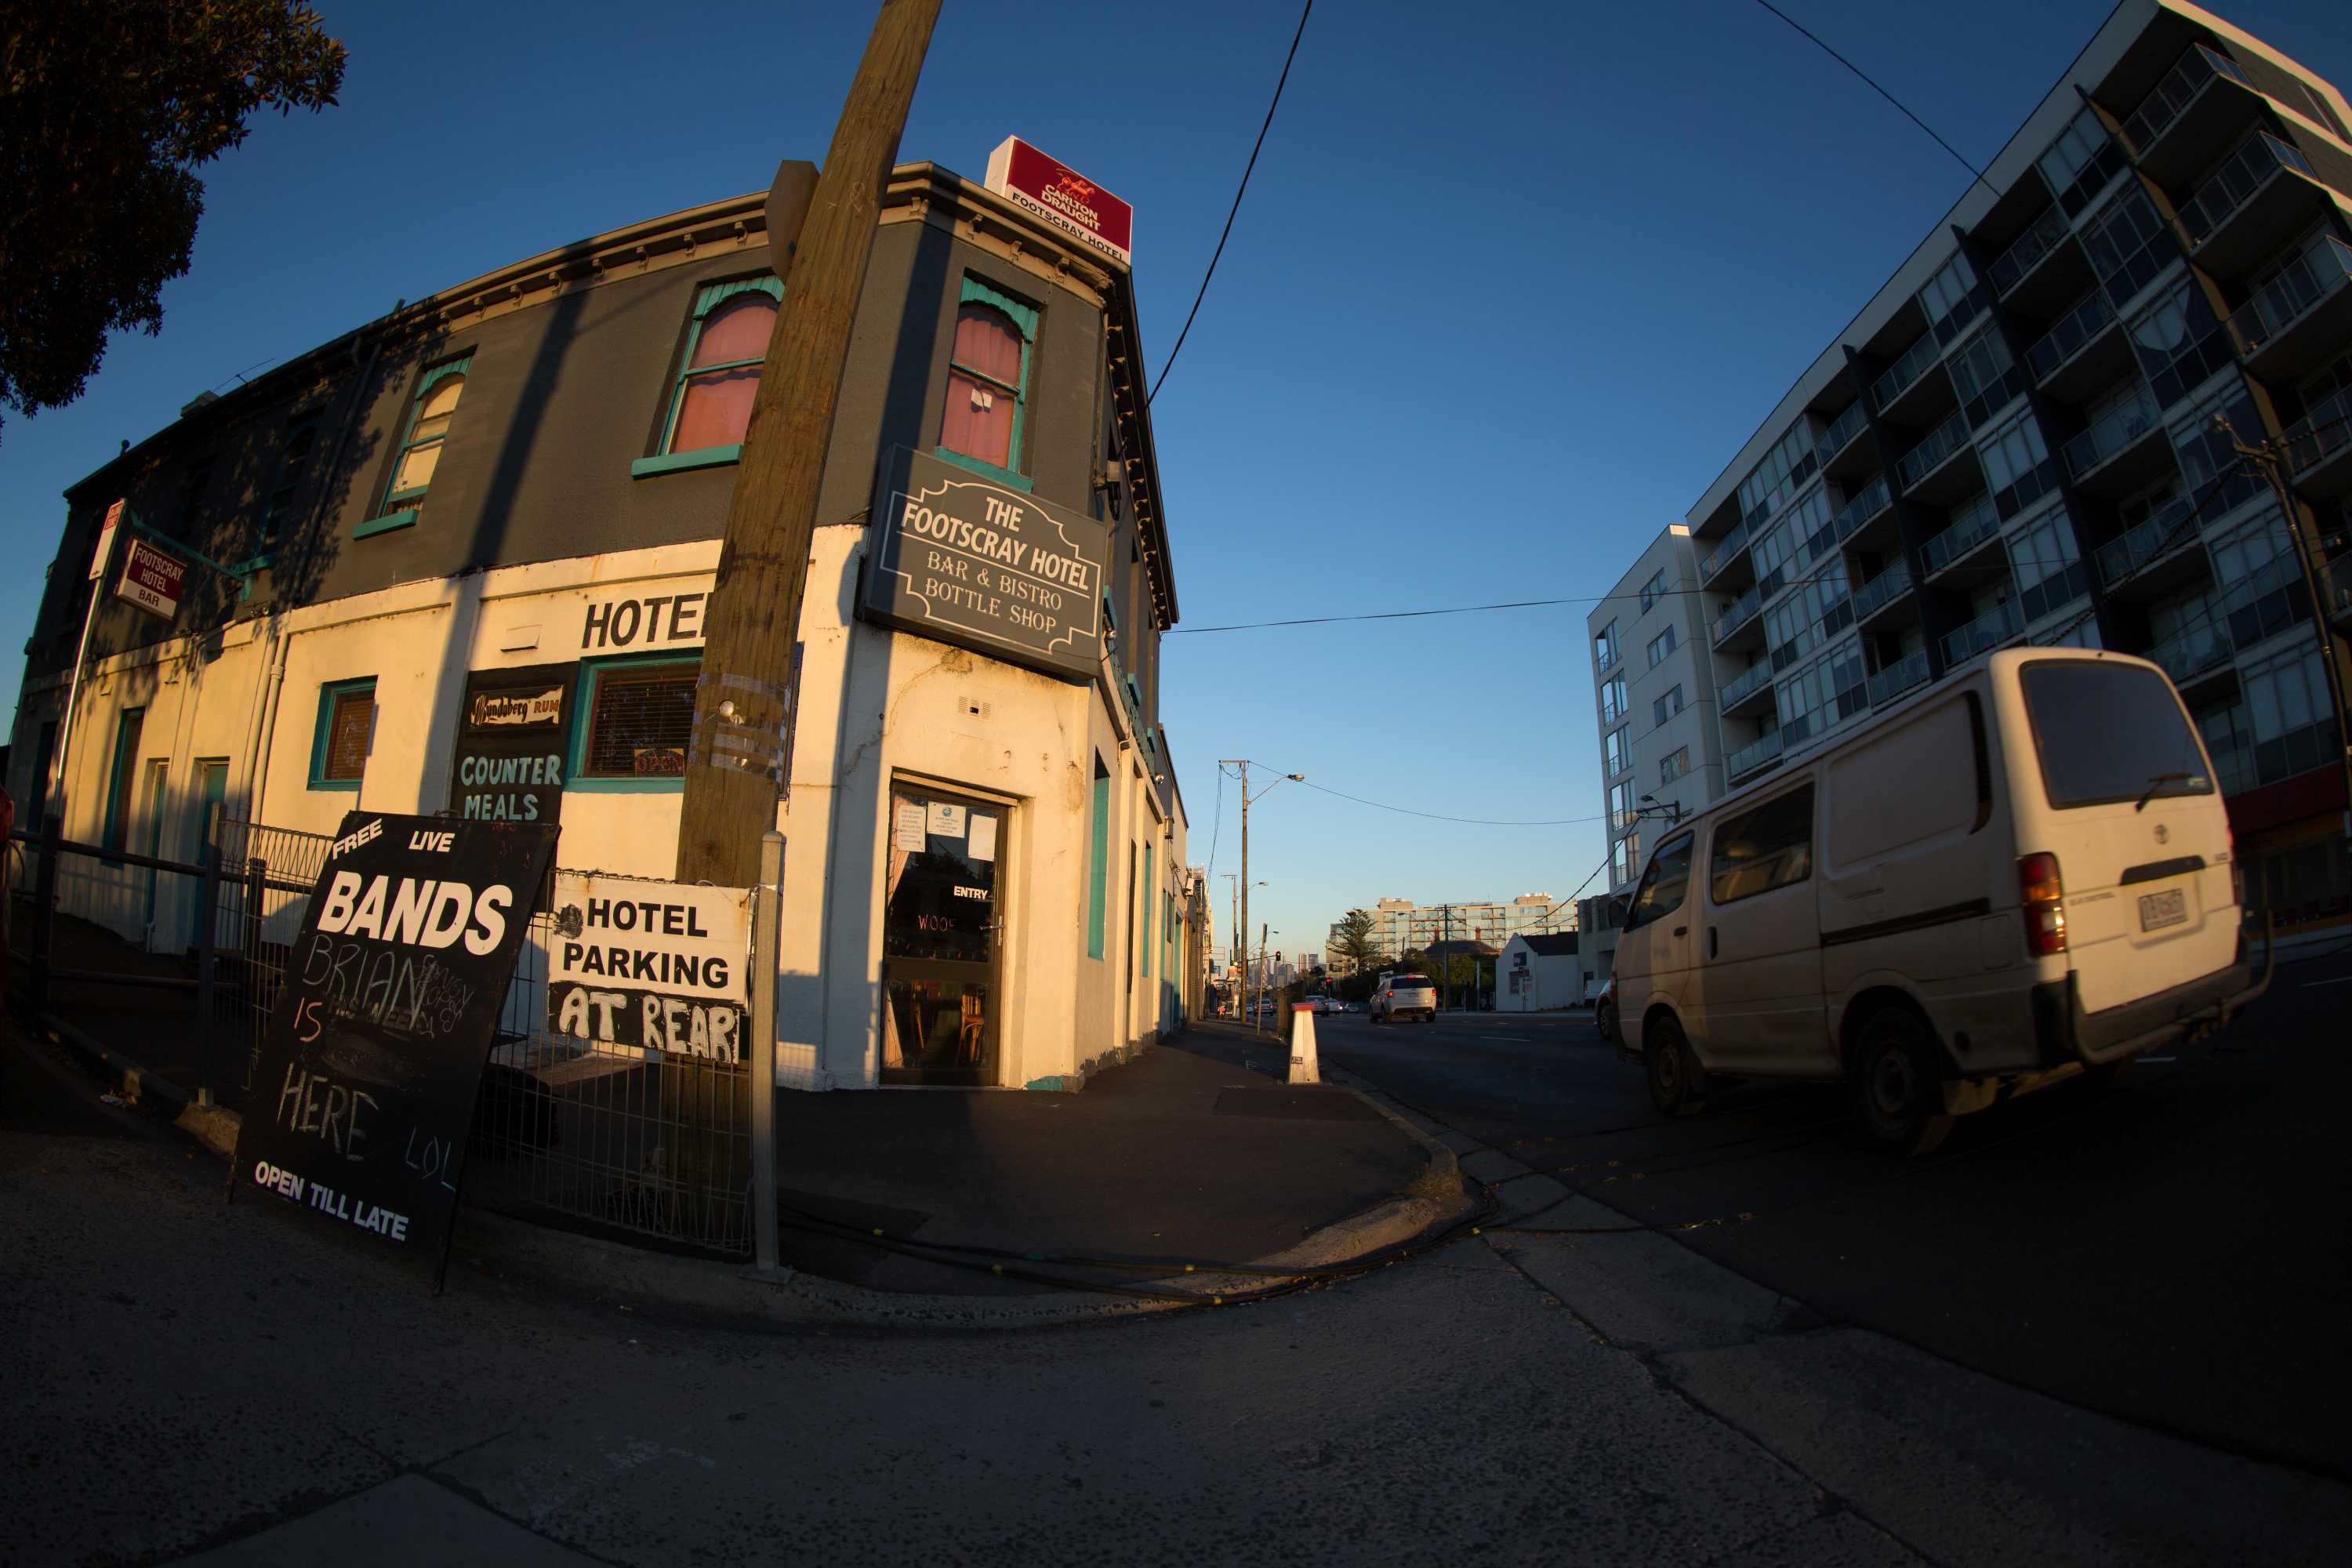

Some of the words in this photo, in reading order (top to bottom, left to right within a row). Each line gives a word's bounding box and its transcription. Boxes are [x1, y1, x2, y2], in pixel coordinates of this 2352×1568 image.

[1012, 192, 1085, 238] FOOTSCRAY
[1041, 191, 1101, 230] DRAUGHT
[1044, 184, 1098, 220] CARLTON
[985, 496, 1023, 532] THE
[135, 547, 184, 582] FOOTSCRAY
[901, 502, 1028, 566] FOOTSCRAY
[1030, 547, 1089, 590] HOTEL
[138, 589, 160, 607] BAR
[141, 568, 167, 593] HOTEL
[927, 551, 968, 581] BAR
[977, 568, 991, 587] &
[999, 575, 1062, 610] BISTRO
[925, 578, 1000, 617] BOTTLE
[1010, 605, 1056, 633] SHOP
[534, 699, 559, 714] RUM
[460, 754, 561, 786] COUNTER
[464, 793, 539, 821] MEALS
[332, 818, 383, 860] FREE
[408, 829, 456, 852] LIVE
[317, 870, 513, 956] BANDS
[953, 885, 988, 899] ENTRY
[587, 898, 707, 938] HOTEL
[302, 934, 436, 1031] BRIAN
[564, 942, 728, 989] PARKING
[294, 997, 323, 1042] IS
[559, 987, 626, 1041] AT
[643, 995, 735, 1063] REAR
[277, 1062, 379, 1161] HERE
[406, 1124, 456, 1192] LOL
[255, 1161, 304, 1200] OPEN
[310, 1182, 349, 1220] TILL
[354, 1200, 409, 1242] LATE
